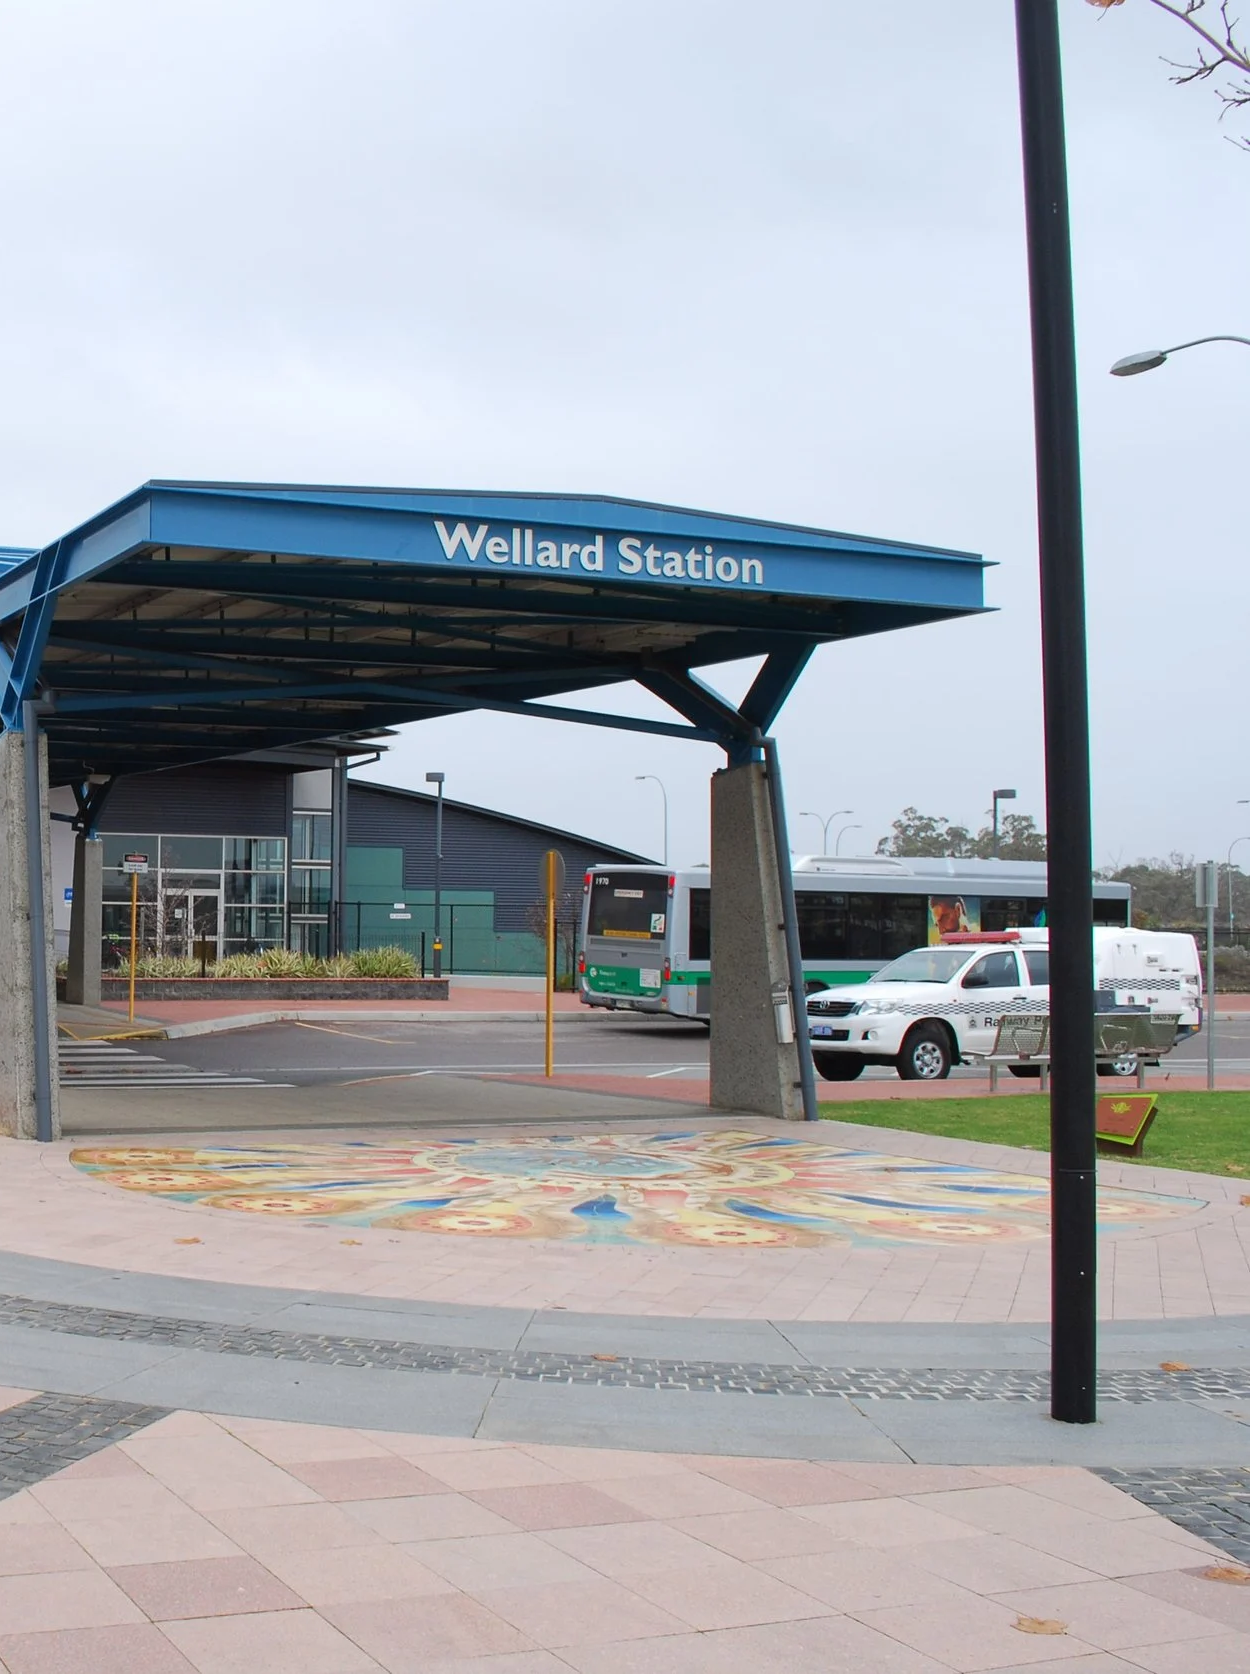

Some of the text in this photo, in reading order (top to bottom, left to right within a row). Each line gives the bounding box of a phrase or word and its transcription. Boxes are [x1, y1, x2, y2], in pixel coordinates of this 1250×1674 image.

[433, 520, 764, 585] Wellard Station
[595, 877, 610, 885] 1970
